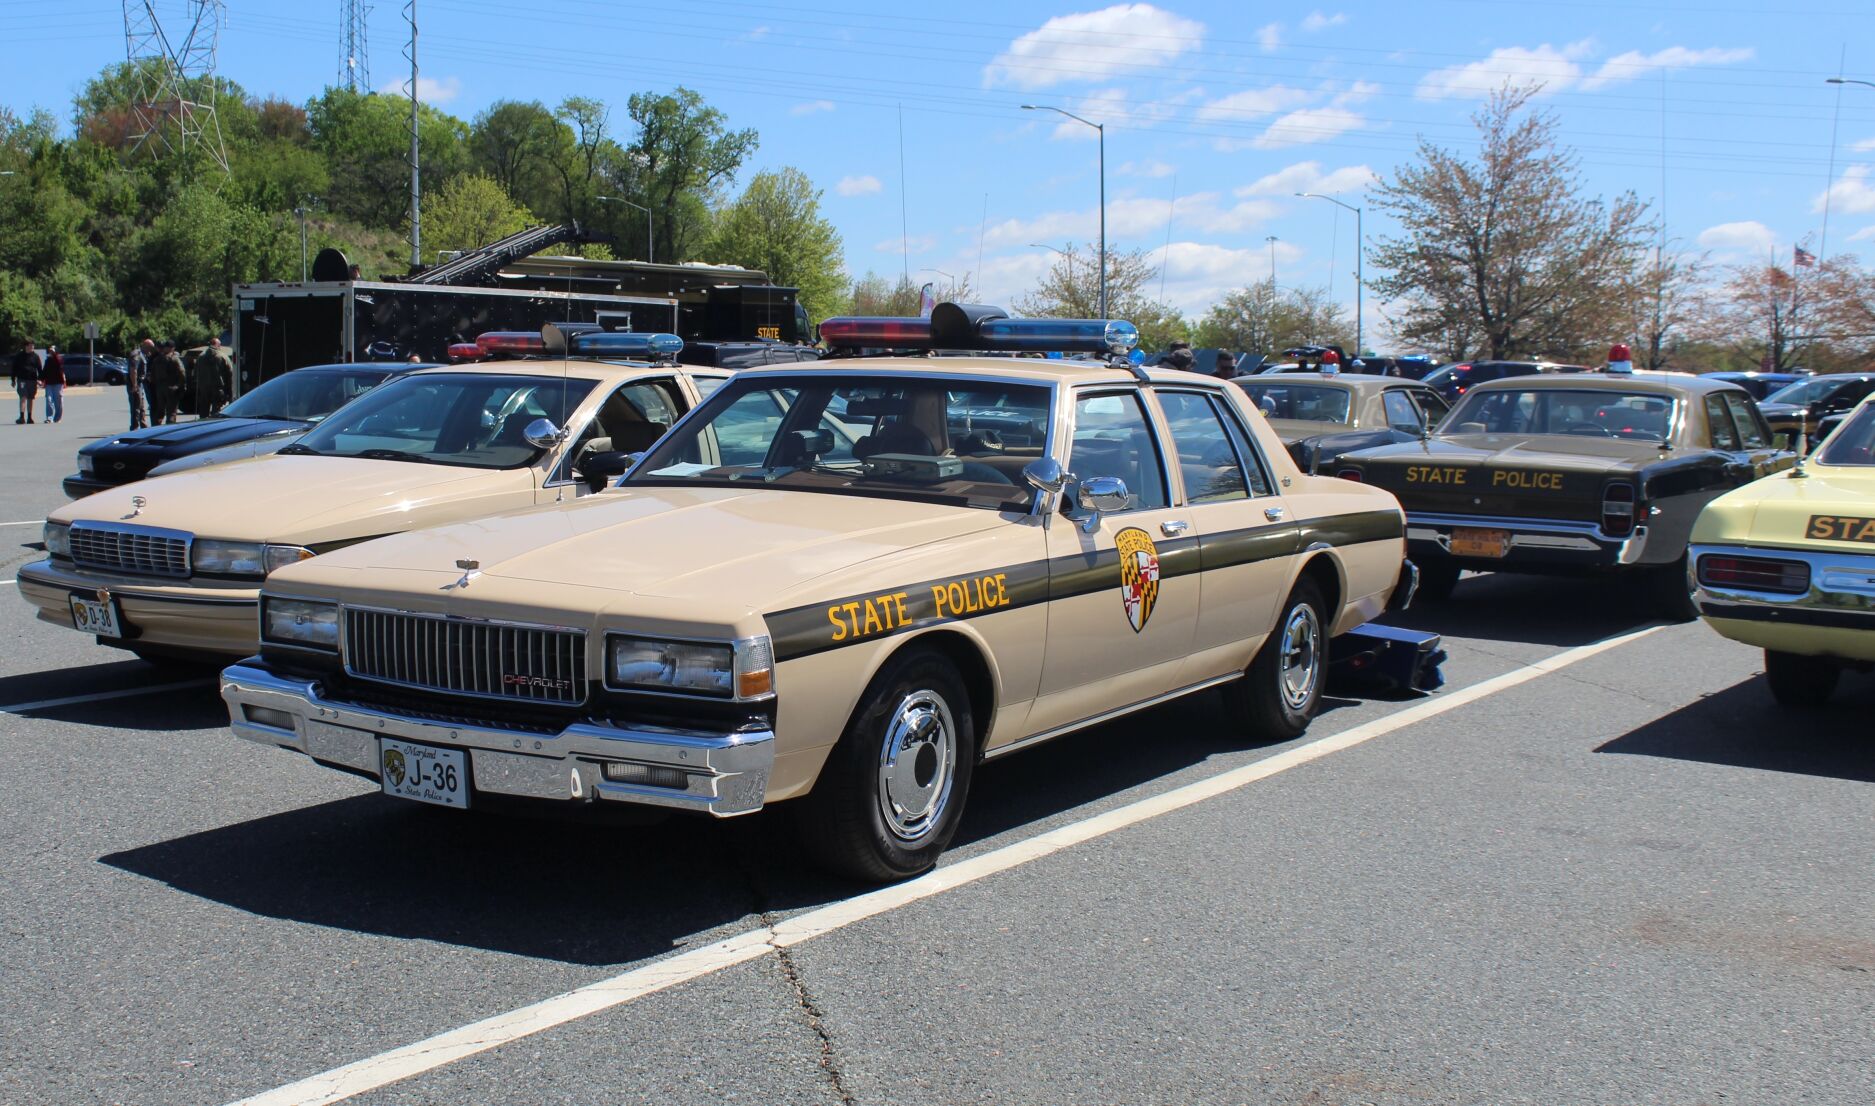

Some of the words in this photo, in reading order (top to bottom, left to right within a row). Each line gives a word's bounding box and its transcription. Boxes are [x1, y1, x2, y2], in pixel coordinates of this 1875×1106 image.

[757, 327, 780, 339] STATE
[1406, 466, 1468, 485] STATE
[1492, 470, 1565, 490] POLICE
[1118, 531, 1149, 541] MARYLAND
[827, 591, 913, 641] STATE
[930, 573, 1011, 619] POLICE
[89, 606, 112, 628] D-38
[503, 674, 570, 690] CHEVROLET
[403, 745, 437, 761] Maryland
[409, 759, 458, 792] J-36
[404, 785, 422, 797] State
[423, 788, 442, 801] Police
